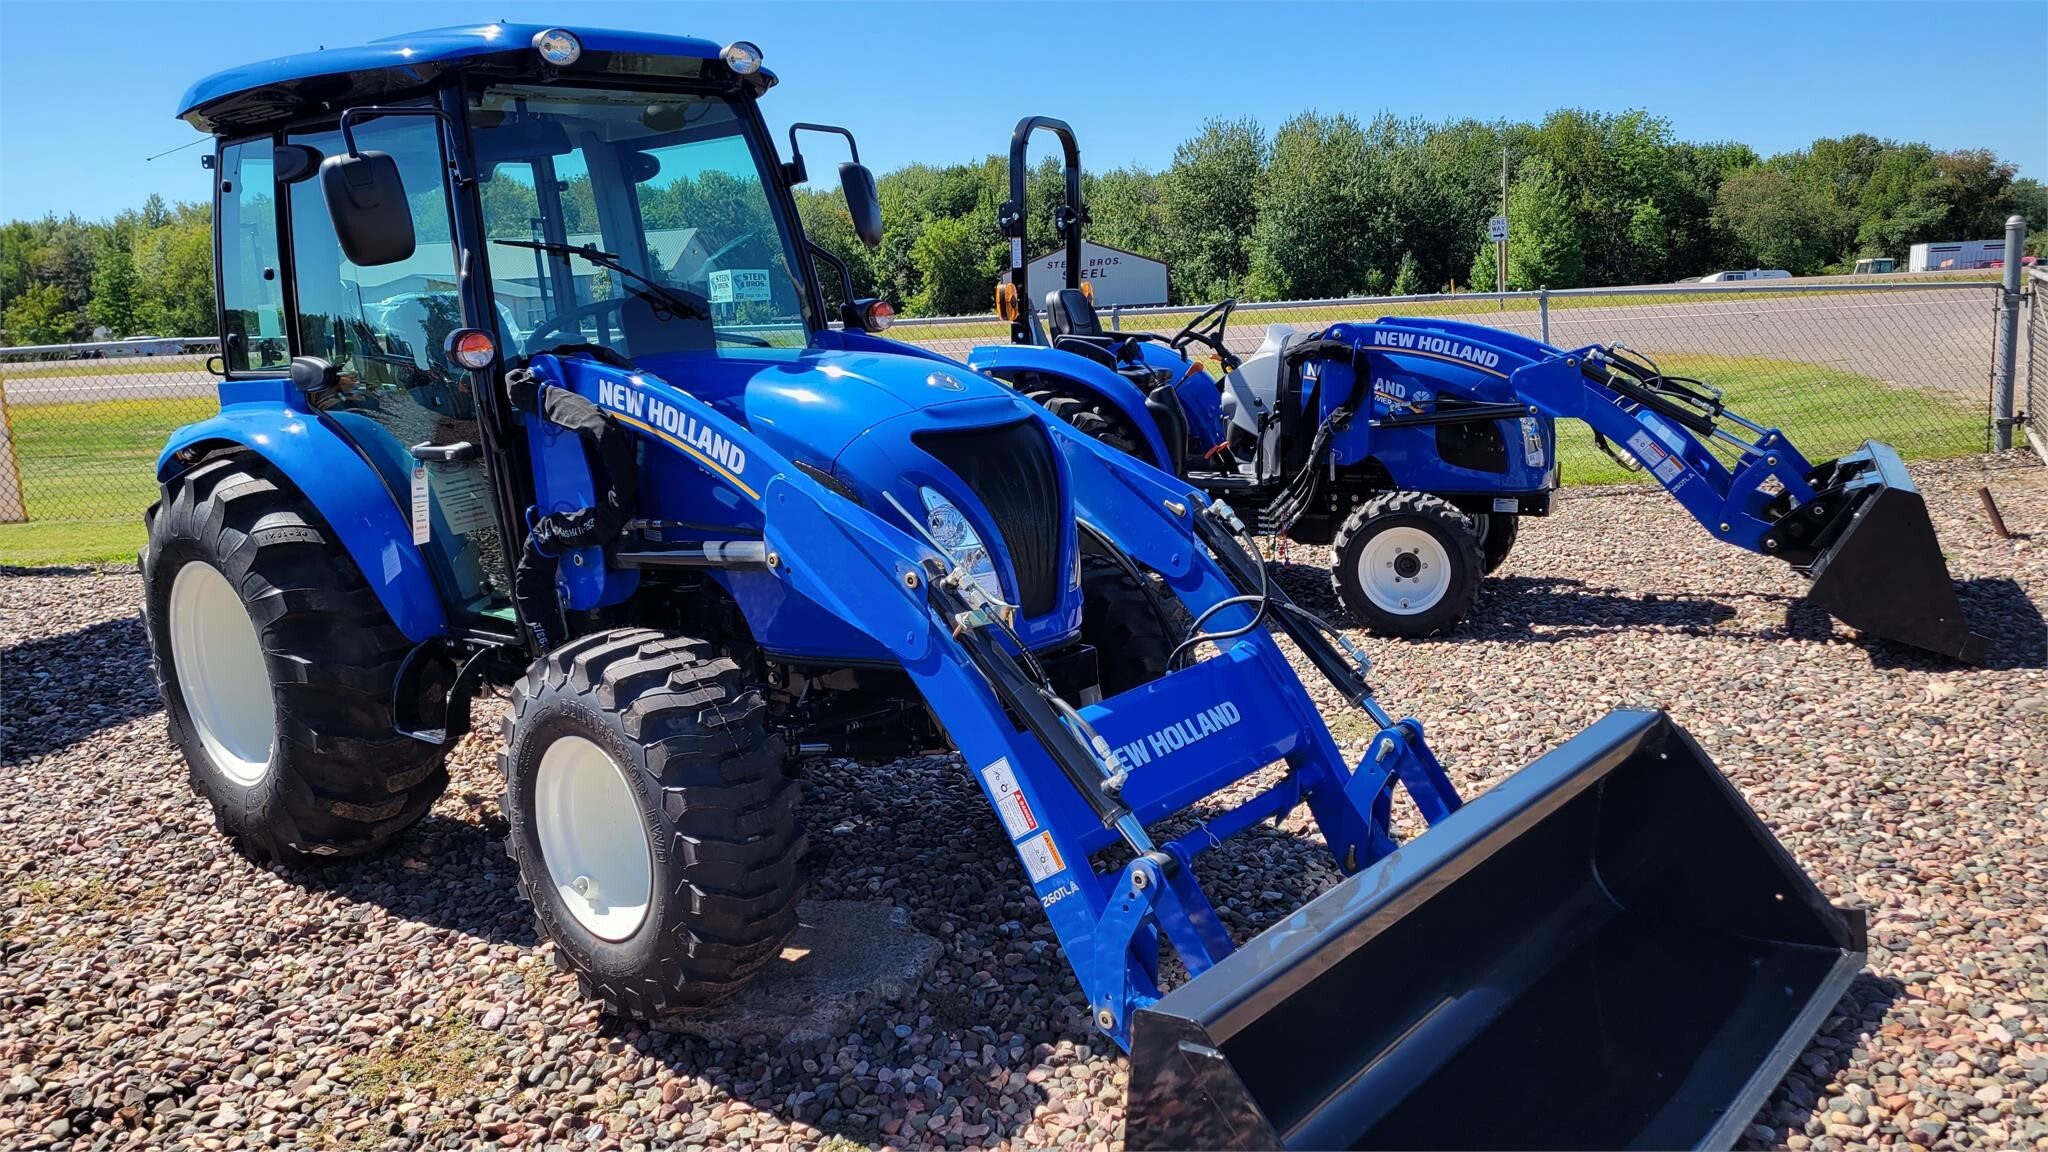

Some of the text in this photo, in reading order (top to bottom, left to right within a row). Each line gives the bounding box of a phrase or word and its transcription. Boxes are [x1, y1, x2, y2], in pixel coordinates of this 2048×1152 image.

[743, 272, 766, 280] STEIN
[1047, 257, 1122, 269] STE BROS.
[1062, 269, 1107, 280] SEEL
[1374, 331, 1499, 368] NEW HOLLAND
[599, 379, 746, 475] NEW HOLLAND
[1111, 701, 1241, 774] EW HOLLAND
[1019, 800, 1035, 827] DANGER
[1041, 880, 1080, 908] 260TLA
